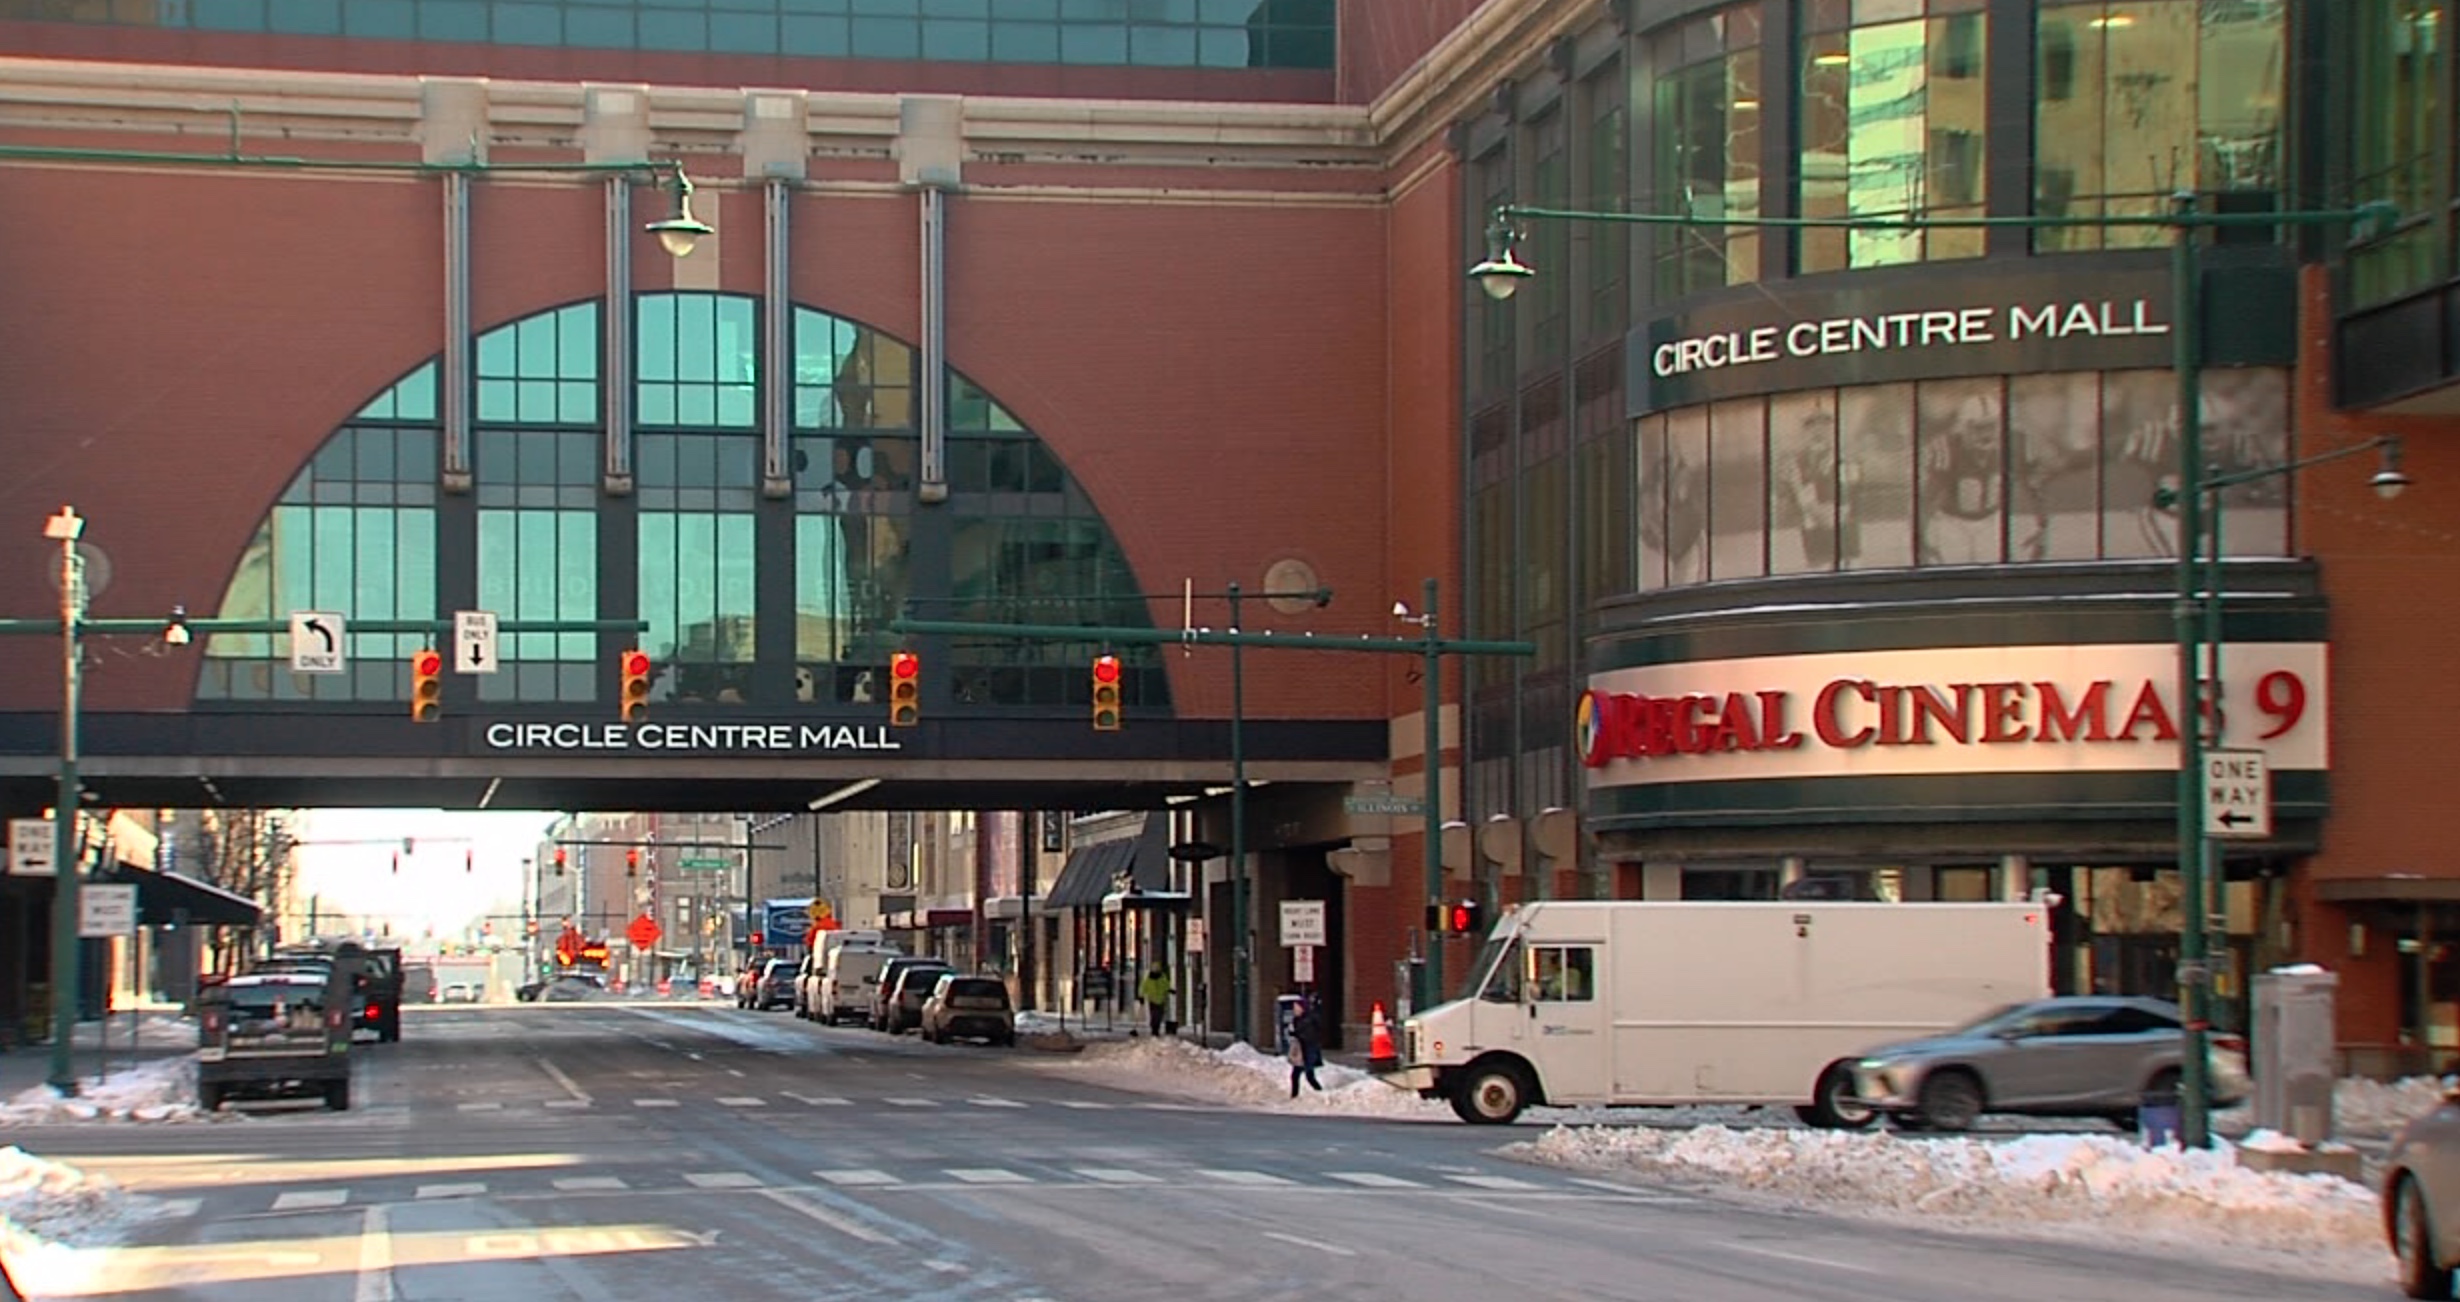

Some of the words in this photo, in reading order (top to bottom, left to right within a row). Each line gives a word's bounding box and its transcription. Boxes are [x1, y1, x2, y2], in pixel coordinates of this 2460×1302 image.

[1653, 327, 1779, 376] CIRCLE
[1786, 308, 1995, 356] CENTRE
[2009, 300, 2170, 339] MALL
[466, 615, 487, 626] BUS
[463, 629, 490, 641] ONLY
[300, 655, 336, 668] ONLY
[1609, 690, 1803, 757] REGAL
[2256, 669, 2307, 741] 9
[486, 723, 628, 749] CIRCLE
[636, 723, 792, 749] CENTRE
[801, 725, 901, 750] MALL
[2211, 760, 2259, 779] ONE
[2211, 787, 2261, 804] WAY
